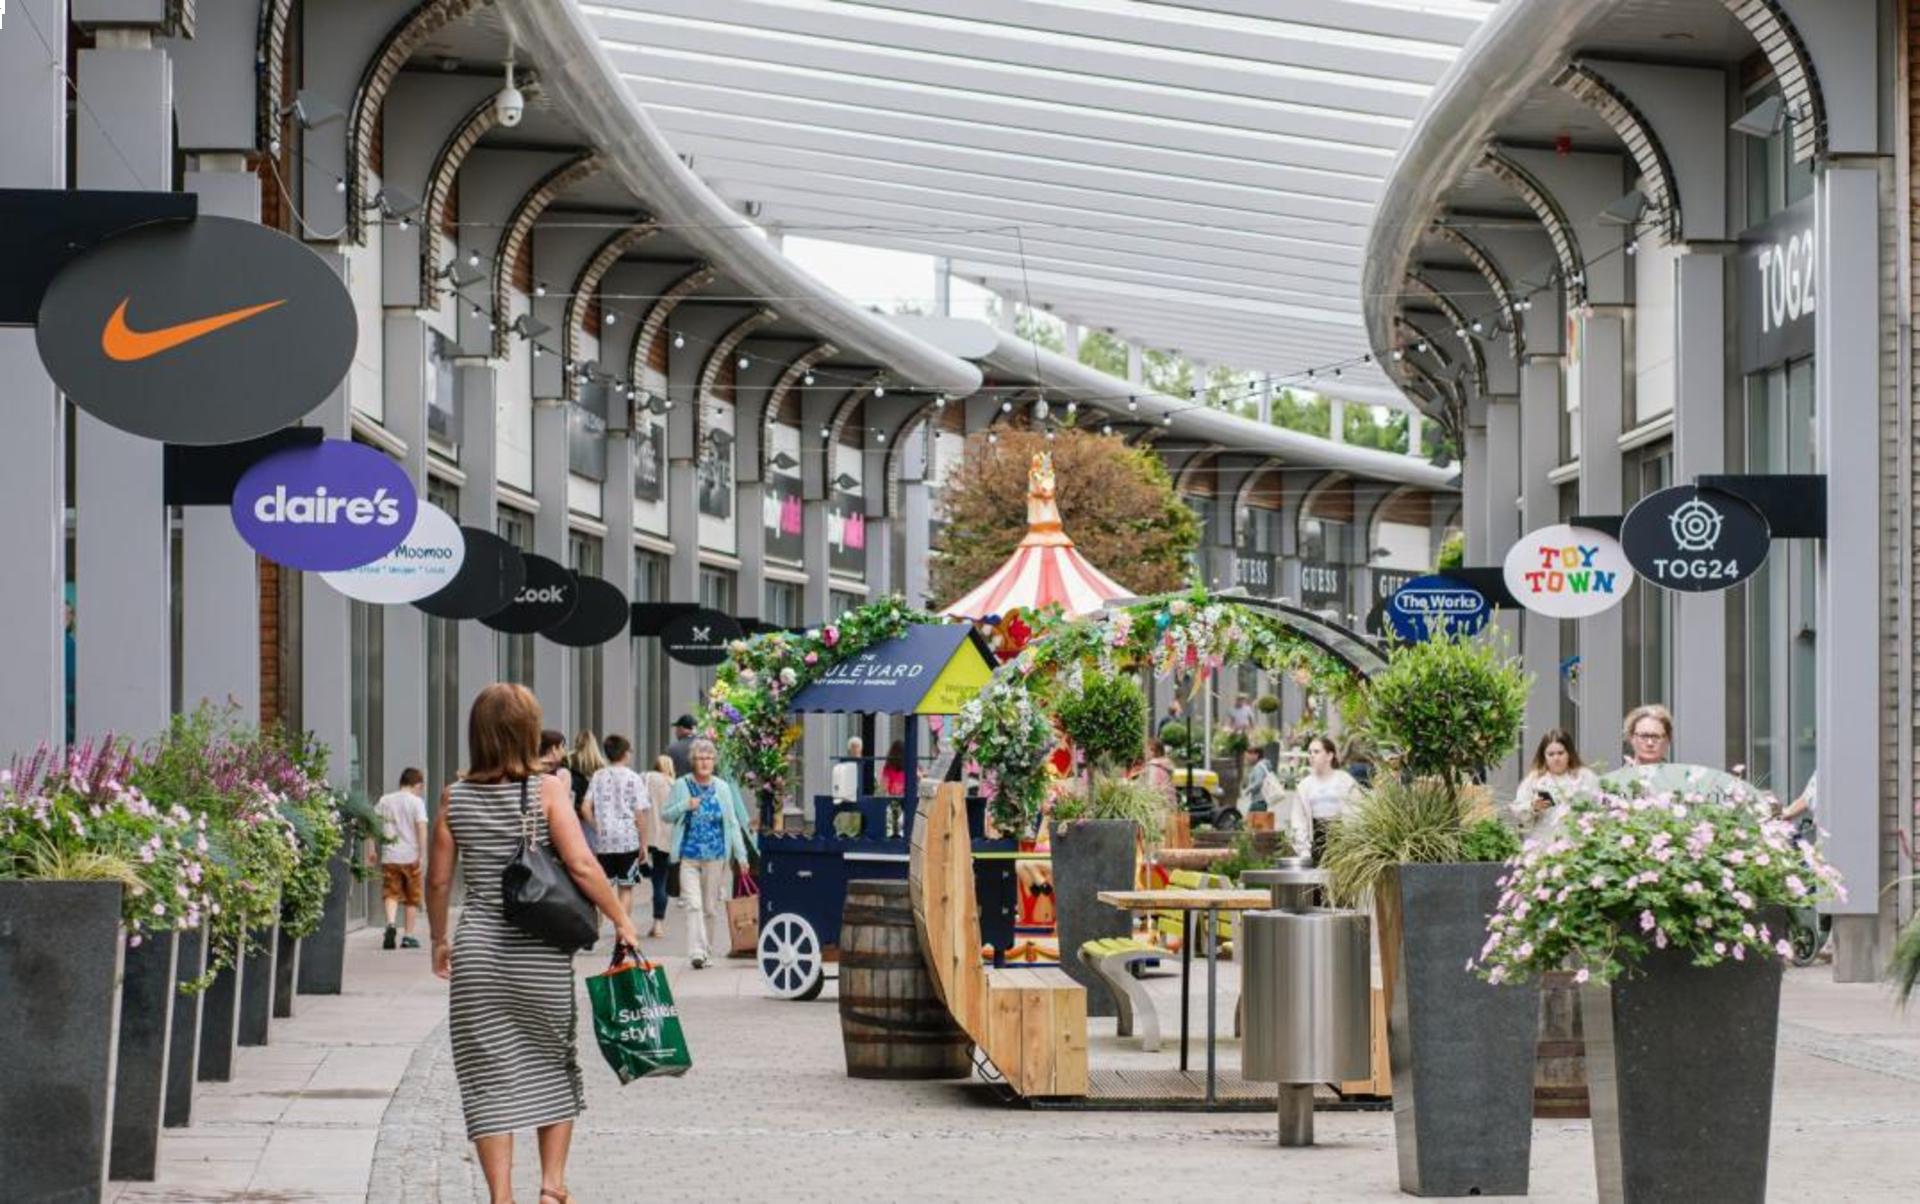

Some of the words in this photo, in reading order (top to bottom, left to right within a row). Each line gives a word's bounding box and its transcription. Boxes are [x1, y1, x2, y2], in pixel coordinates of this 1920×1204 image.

[1758, 229, 1815, 333] TOG2
[254, 485, 400, 526] claire's
[395, 543, 452, 559] Moomoo
[1539, 545, 1599, 569] TOY
[1301, 566, 1338, 594] GUESS
[1653, 559, 1740, 580] TOG24
[1525, 570, 1616, 594] TOWN
[1401, 595, 1428, 609] The
[1430, 594, 1477, 609] Works
